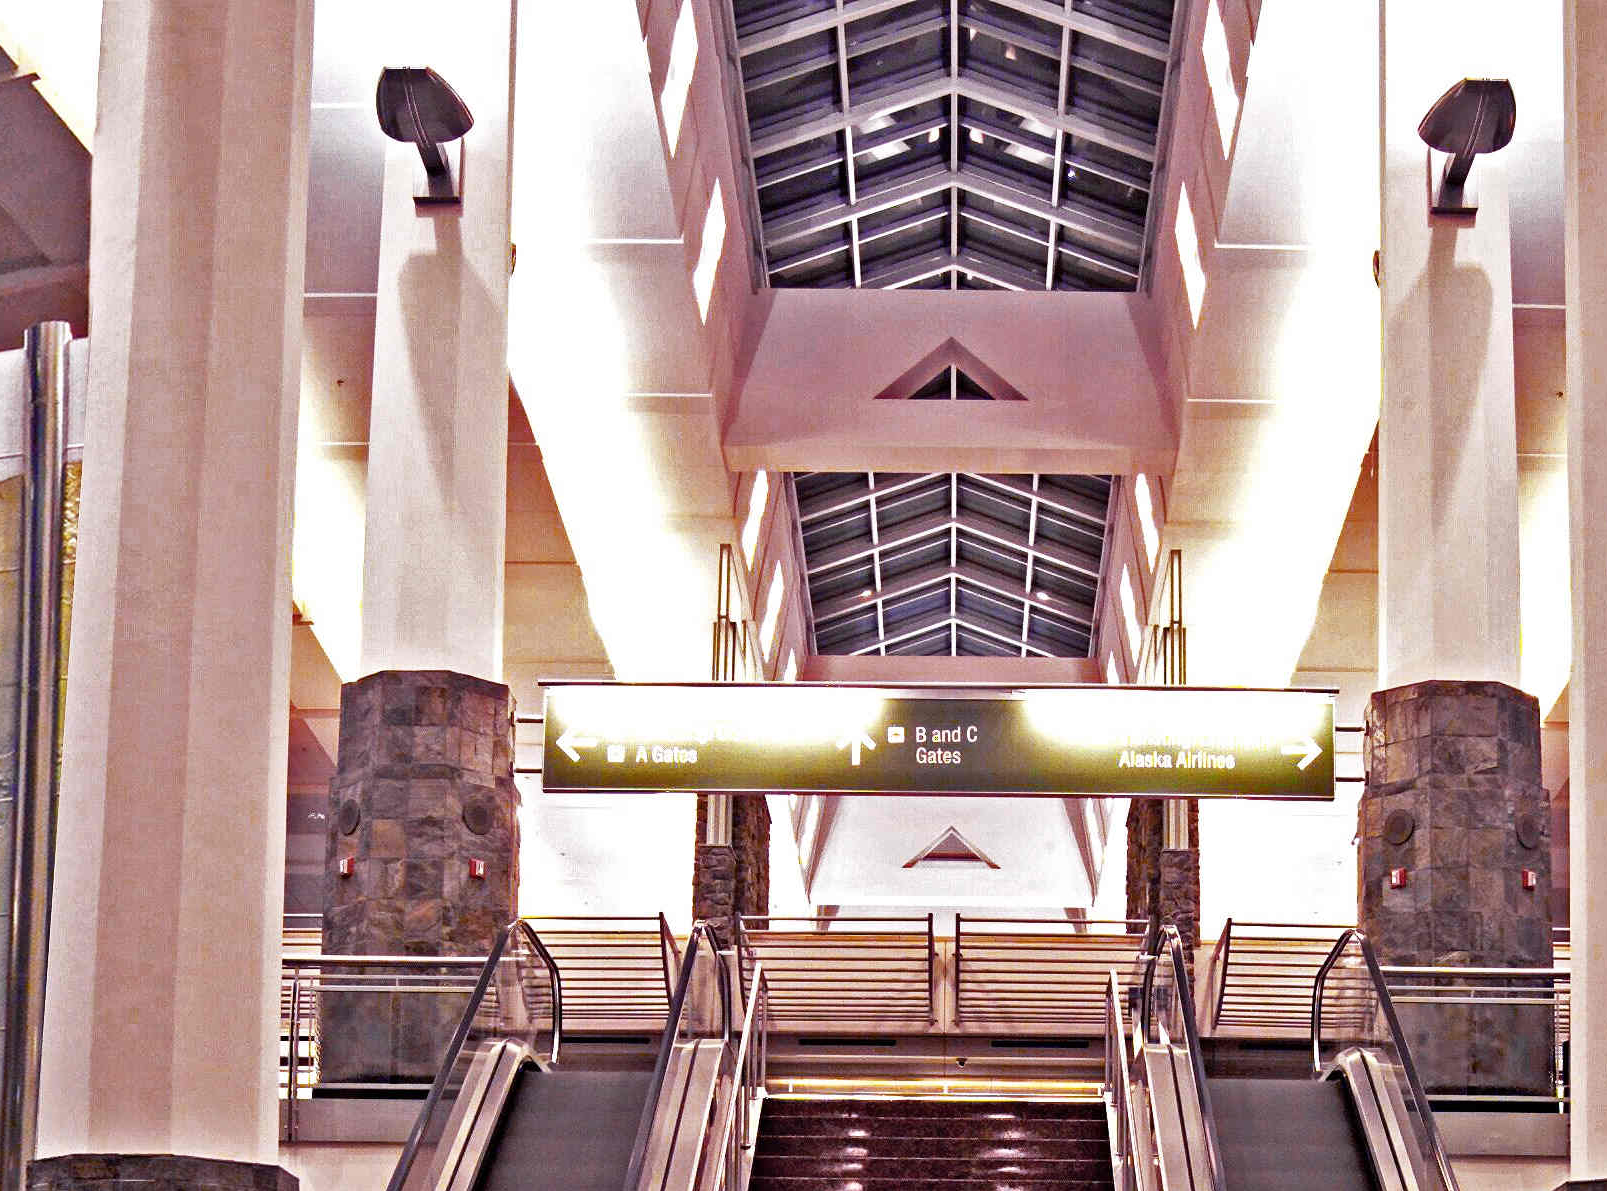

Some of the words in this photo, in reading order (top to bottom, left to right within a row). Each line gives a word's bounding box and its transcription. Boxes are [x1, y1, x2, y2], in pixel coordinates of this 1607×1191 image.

[915, 726, 927, 743] B
[932, 726, 961, 743] and
[966, 725, 978, 743] C
[635, 744, 648, 763] A
[651, 745, 699, 763] Gates
[916, 746, 962, 764] Gates
[1118, 750, 1173, 768] Alaska
[1176, 750, 1236, 769] Airlines
